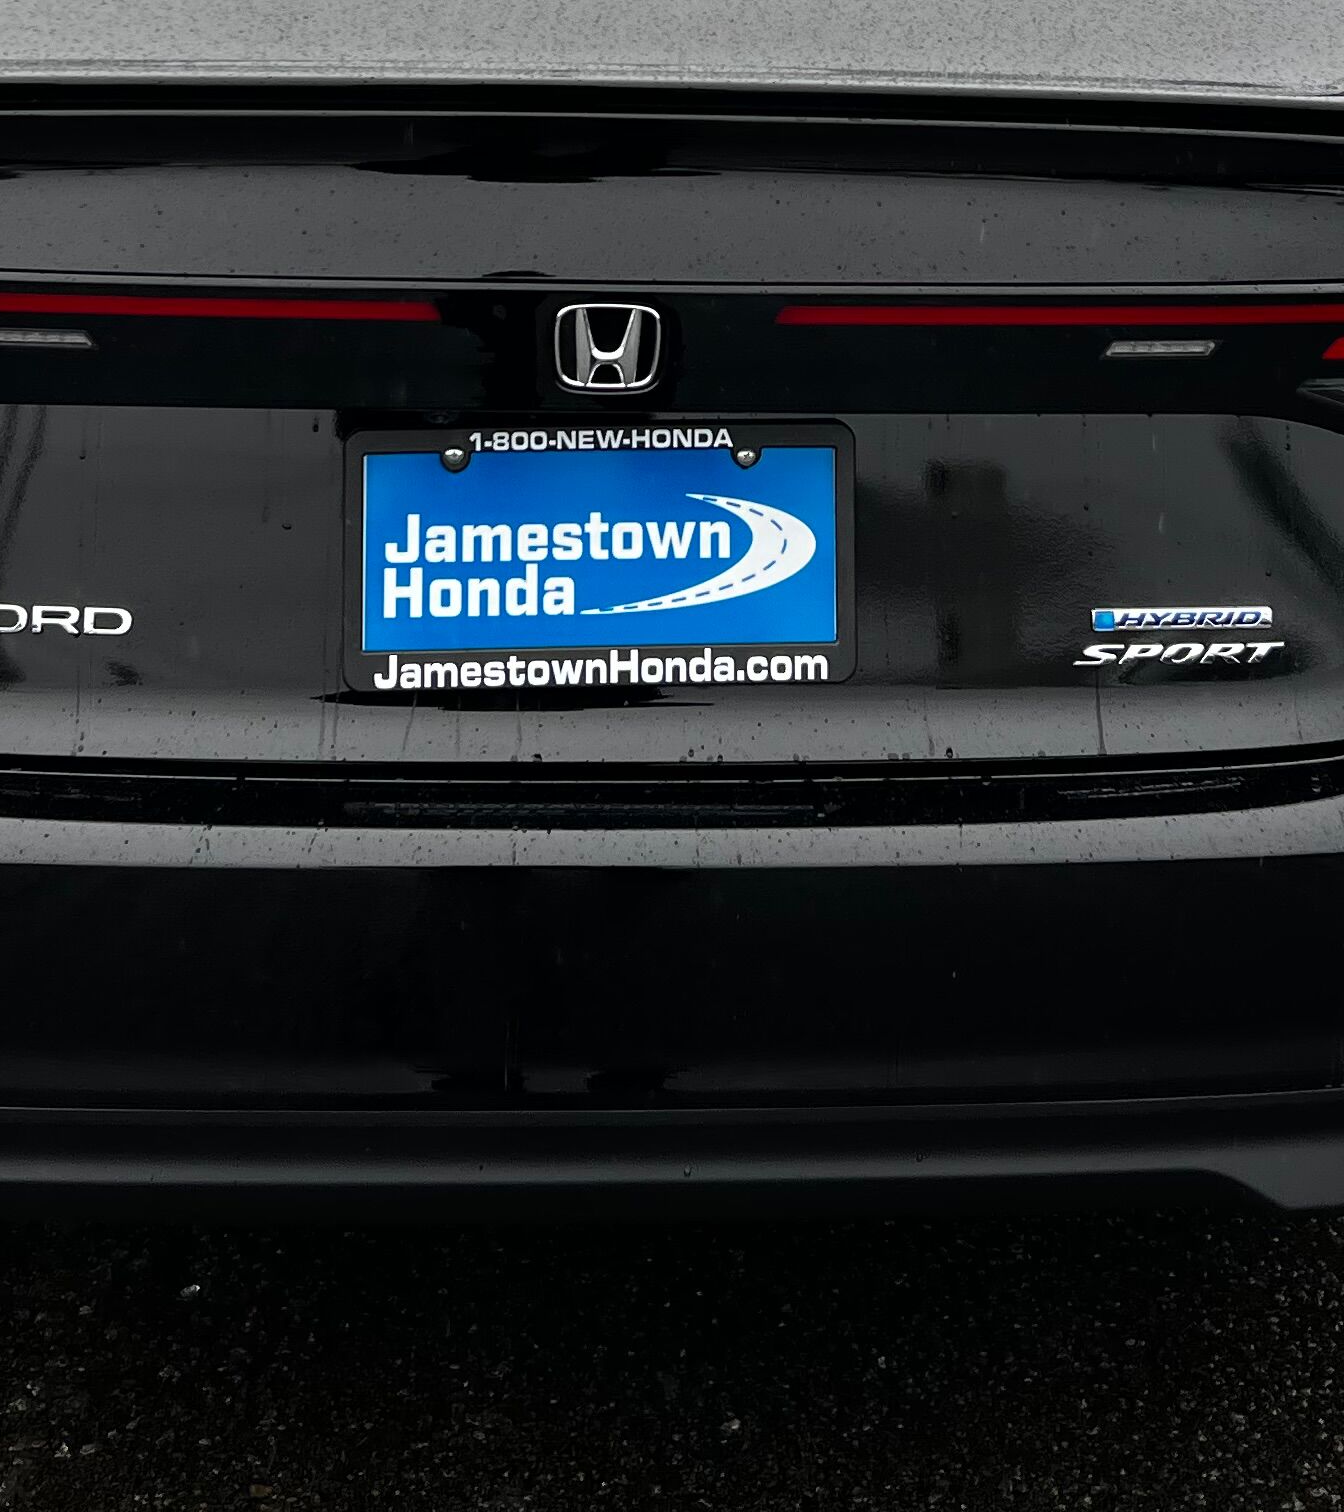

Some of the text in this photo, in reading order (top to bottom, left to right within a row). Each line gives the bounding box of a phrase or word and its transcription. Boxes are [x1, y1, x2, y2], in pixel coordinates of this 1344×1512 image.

[469, 428, 734, 452] 1-800-NEW-HONDA
[384, 511, 732, 564] Jamestown
[383, 563, 575, 619] Honda
[1117, 610, 1263, 628] HYBRID
[373, 647, 829, 689] JamestownHonda.com
[1072, 641, 1286, 666] SPORT
